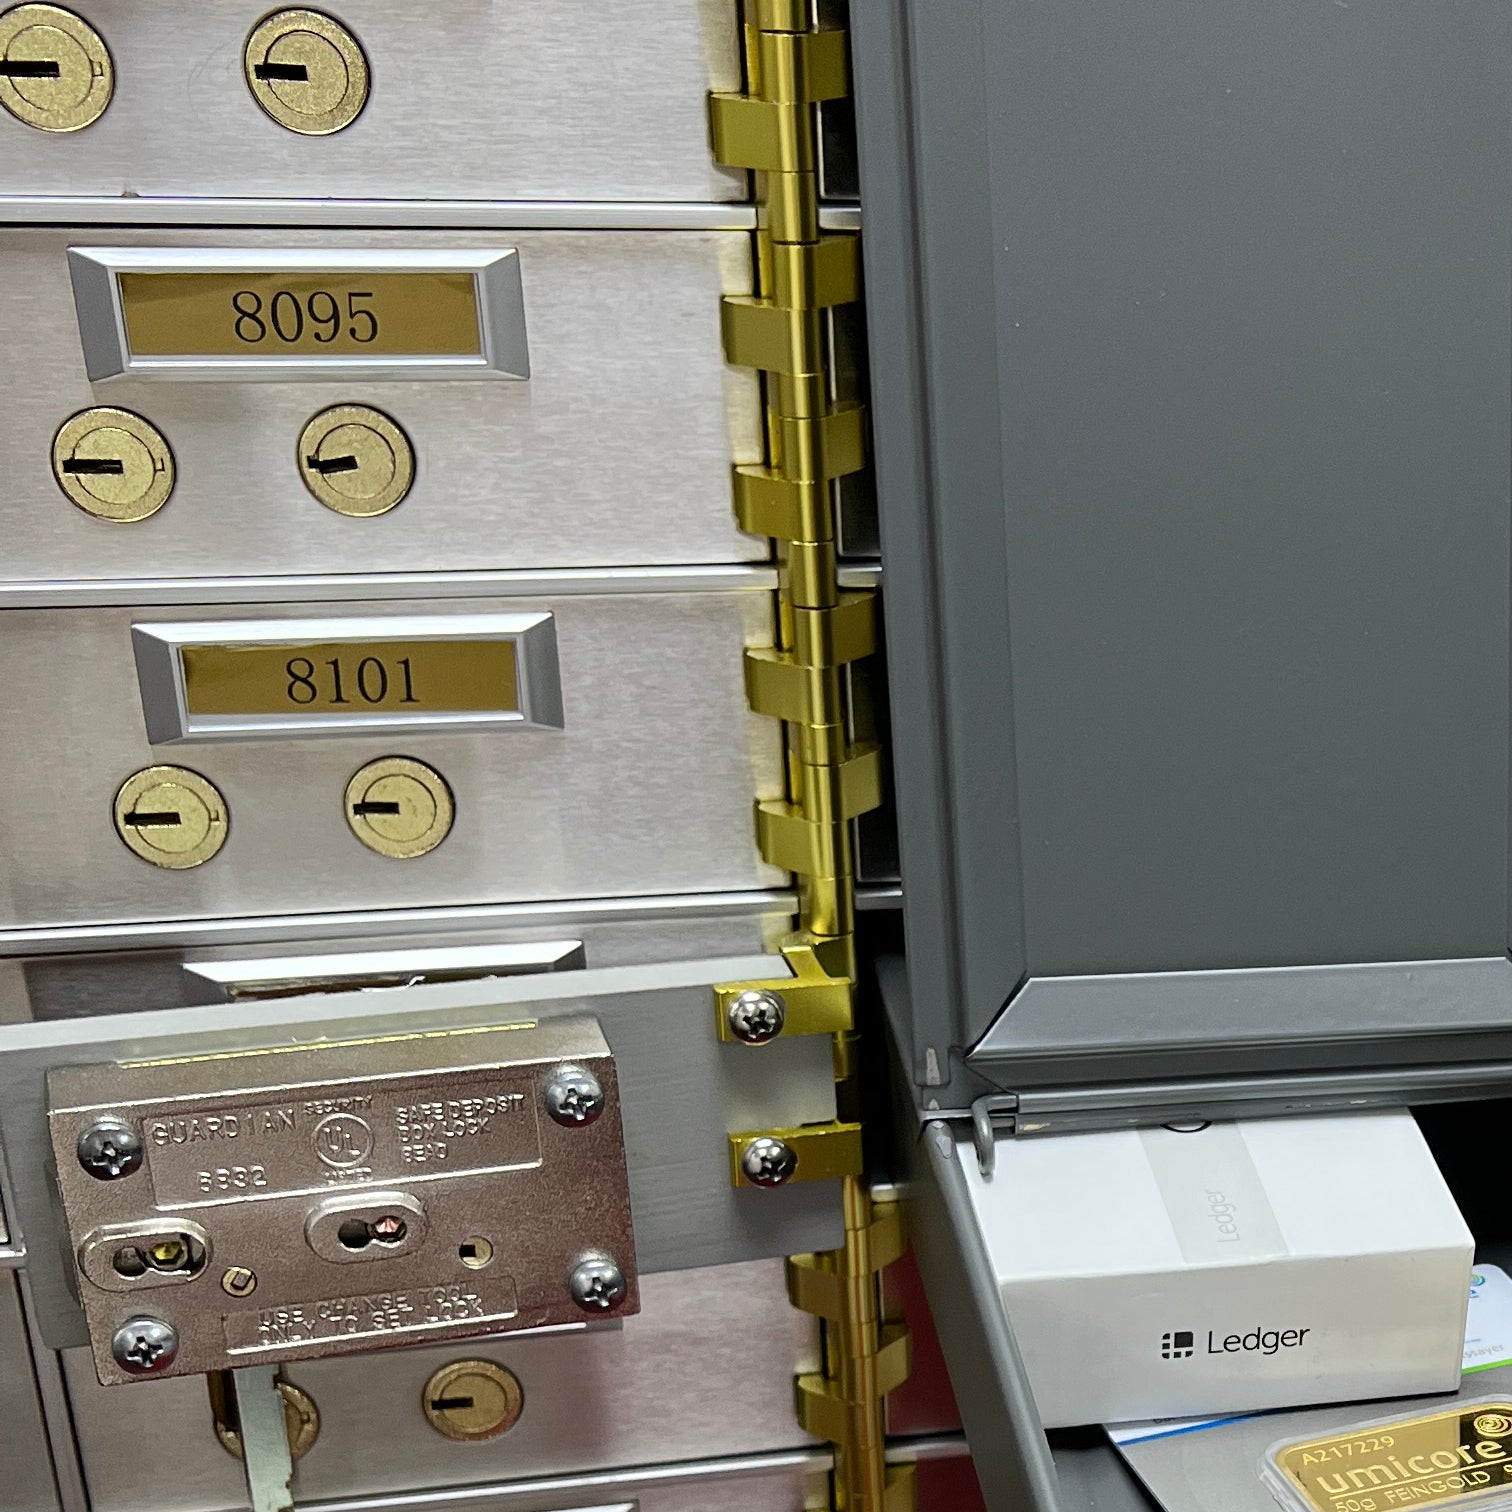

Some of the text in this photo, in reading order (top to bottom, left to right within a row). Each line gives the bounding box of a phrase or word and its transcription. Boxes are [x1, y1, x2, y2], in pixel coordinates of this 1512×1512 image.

[231, 289, 381, 345] 8095
[285, 655, 422, 705] 8101
[152, 1107, 297, 1146] GUARDIAN
[1207, 1326, 1311, 1356] Ledger
[1301, 1435, 1395, 1467] A217229
[1315, 1439, 1508, 1495] umicore
[1386, 1471, 1492, 1505] FEINGOLD
